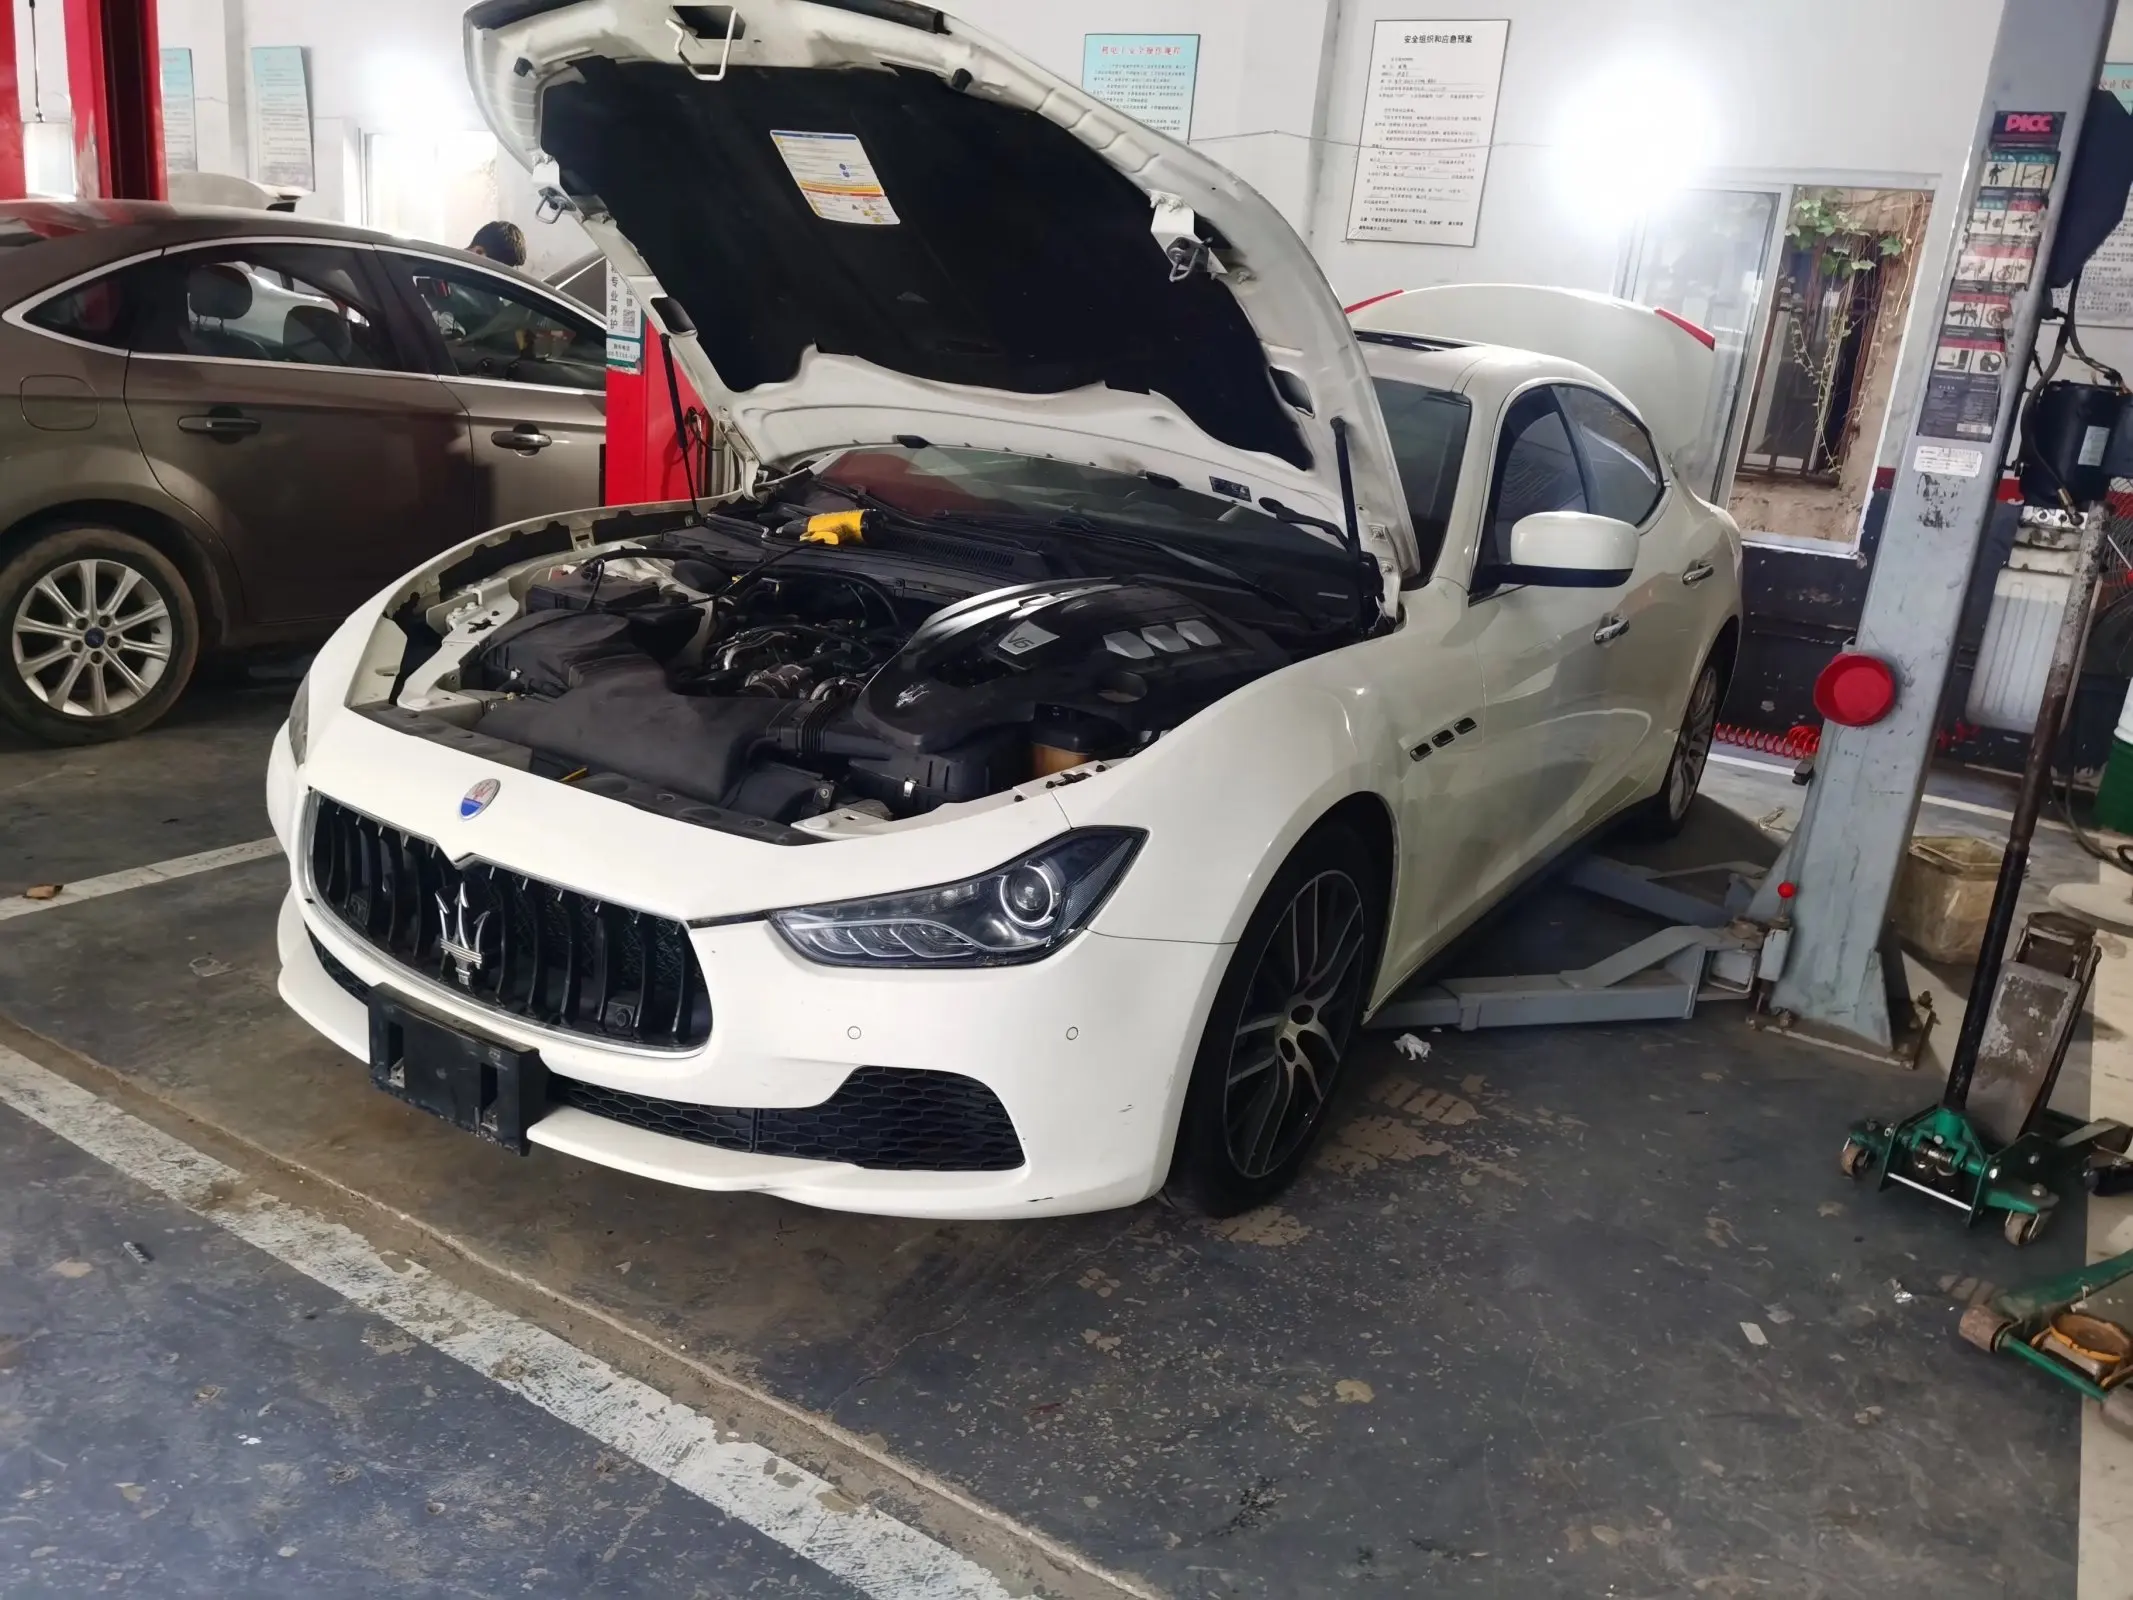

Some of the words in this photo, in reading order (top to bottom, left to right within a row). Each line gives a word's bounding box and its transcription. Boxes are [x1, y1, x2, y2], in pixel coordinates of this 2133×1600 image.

[1404, 34, 1473, 44] 安全组织和应急预案
[2004, 114, 2053, 133] PICC
[1007, 630, 1036, 649] V6
